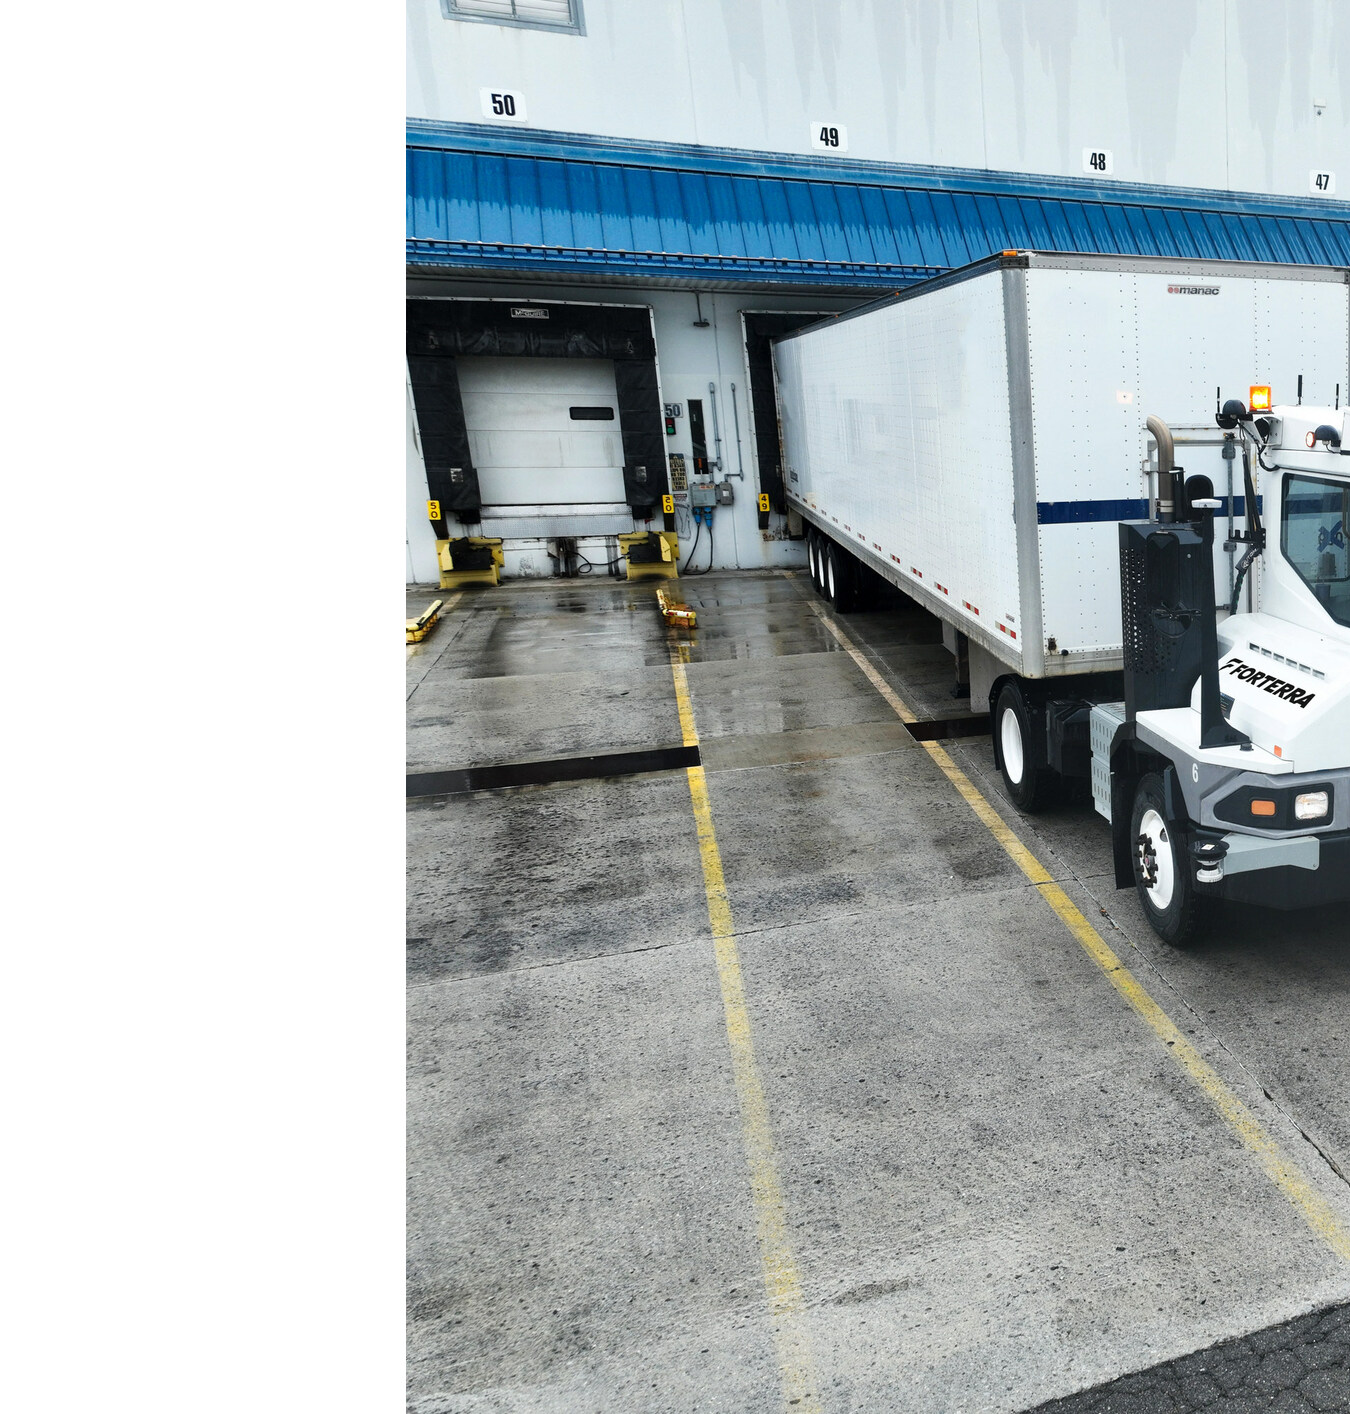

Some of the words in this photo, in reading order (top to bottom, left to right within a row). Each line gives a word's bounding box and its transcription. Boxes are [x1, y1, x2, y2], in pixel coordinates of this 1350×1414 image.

[491, 93, 516, 116] 50
[820, 126, 839, 147] 49
[1090, 152, 1106, 171] 48
[1315, 174, 1330, 190] 47
[1179, 287, 1220, 295] manac
[665, 404, 680, 417] 50
[430, 502, 438, 518] 50
[761, 495, 768, 510] 49
[1229, 663, 1316, 708] FORTERRA
[1192, 762, 1199, 783] 6
